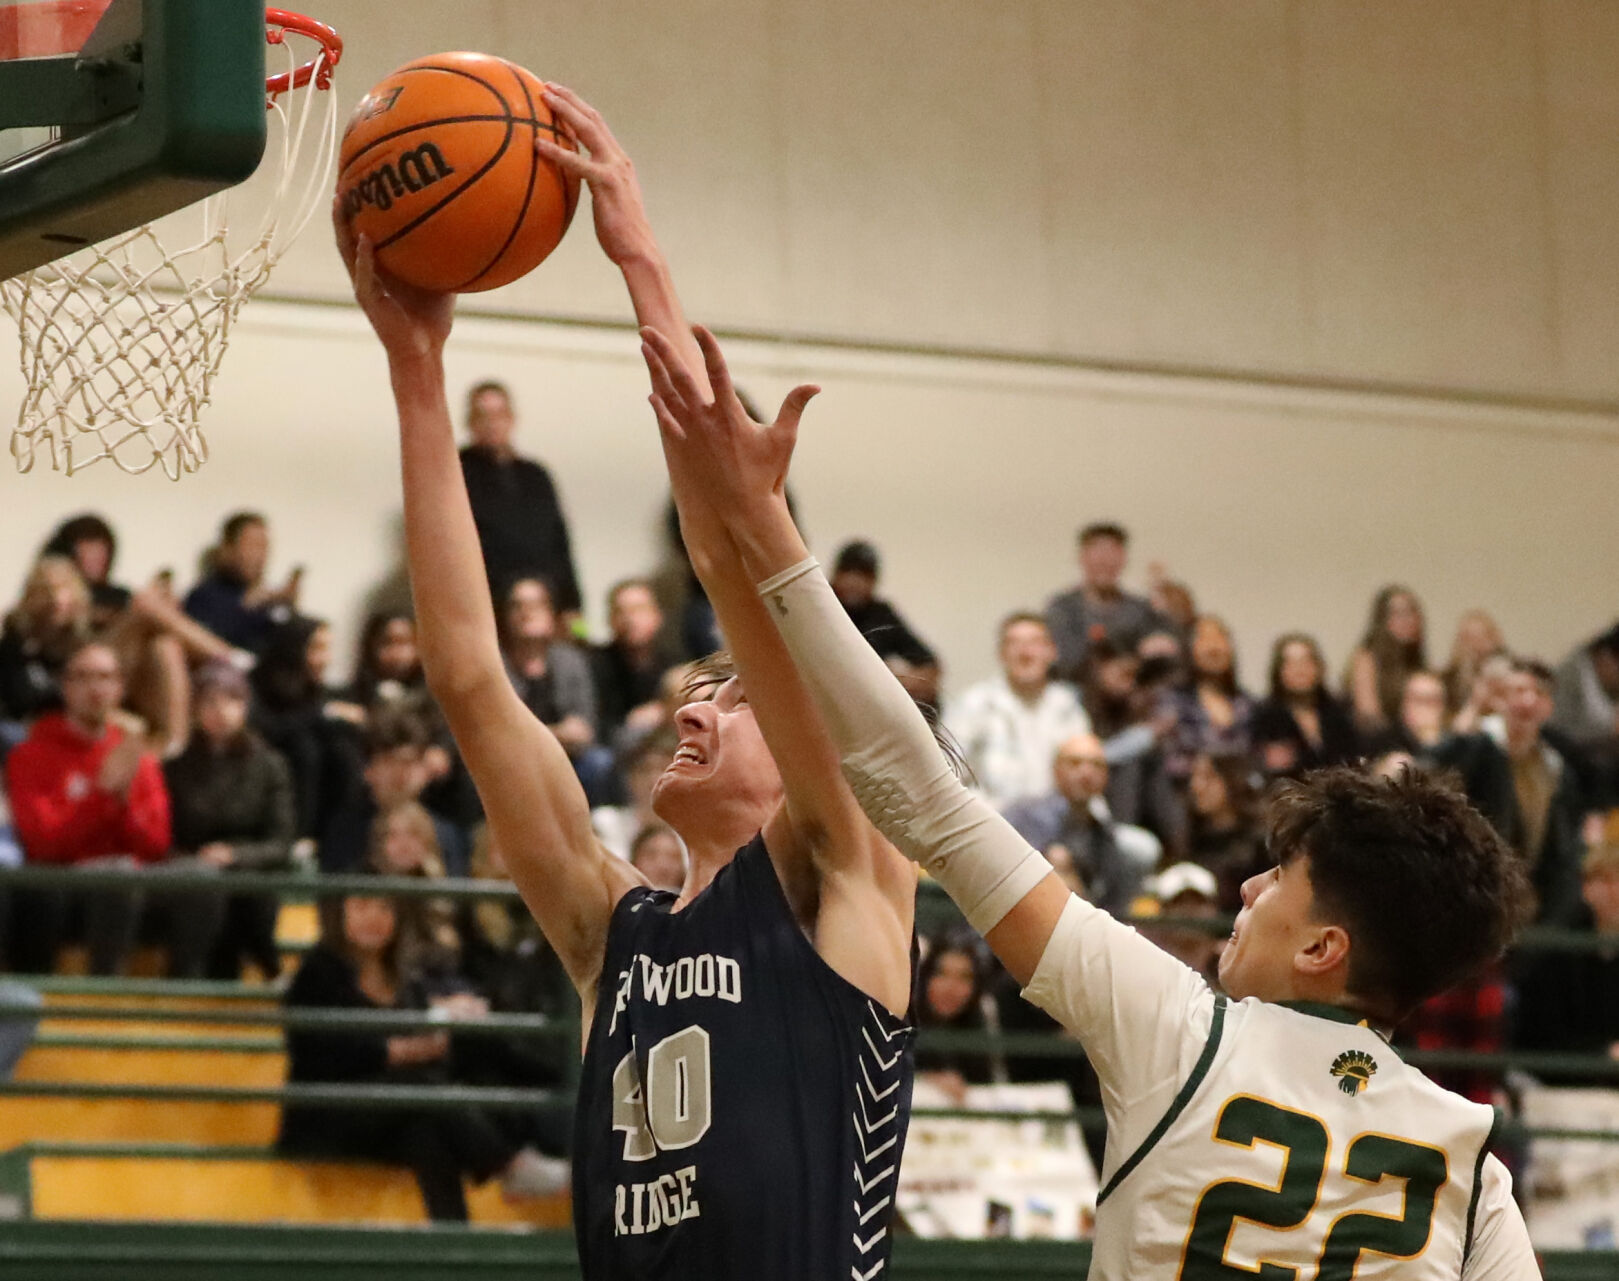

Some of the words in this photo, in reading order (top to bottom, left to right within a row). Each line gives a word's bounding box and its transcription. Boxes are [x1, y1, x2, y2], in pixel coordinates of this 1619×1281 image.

[341, 142, 455, 217] Wilso
[612, 1023, 711, 1161] 40
[1175, 1092, 1450, 1281] 22
